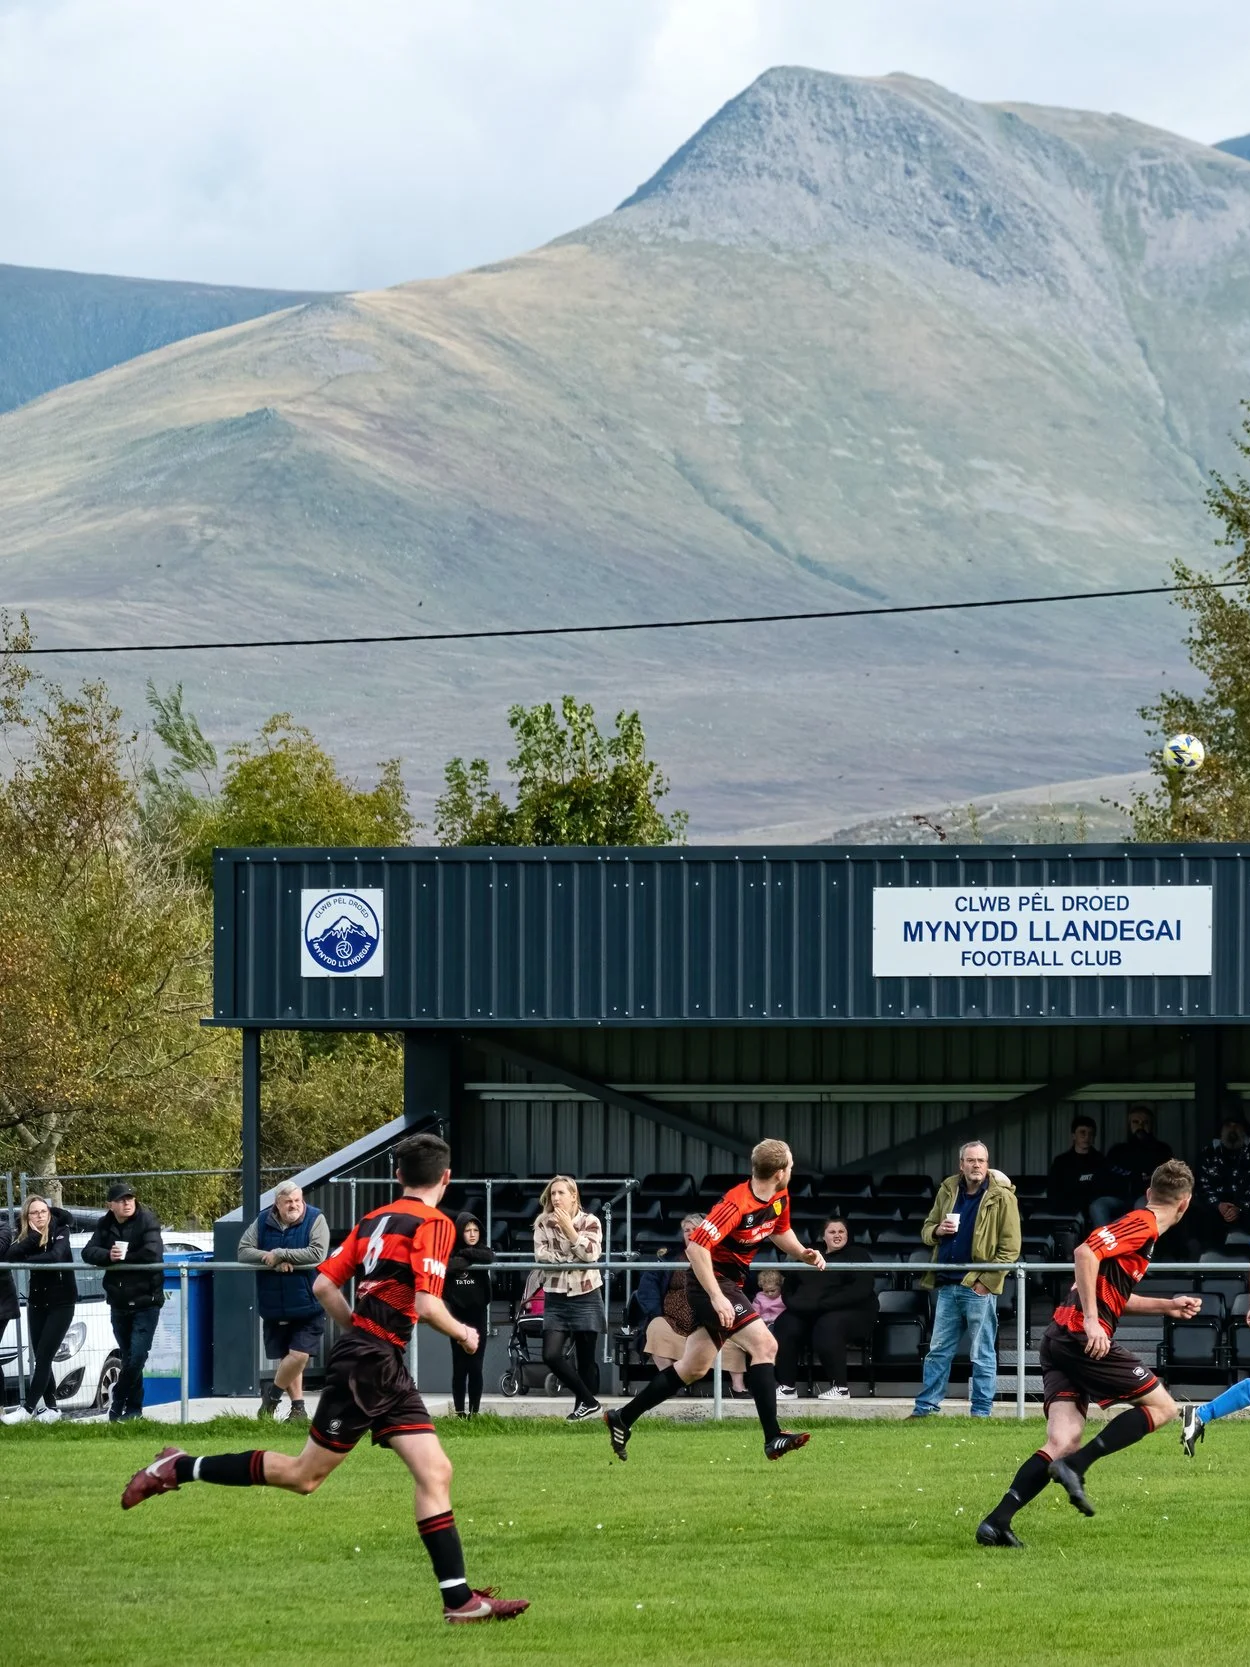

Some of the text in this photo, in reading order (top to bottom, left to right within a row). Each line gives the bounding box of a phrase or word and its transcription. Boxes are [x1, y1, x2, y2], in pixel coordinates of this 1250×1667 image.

[314, 901, 332, 919] CLWB
[348, 899, 369, 919] DROED
[954, 892, 1130, 912] CLWB PÊL DROED
[902, 919, 1182, 943] MYNYDD LLANDEGAI
[312, 942, 372, 968] MYNYDD LLANDEGAI
[961, 949, 1122, 967] FOOTBALL CLUB
[362, 1215, 392, 1276] 6
[1097, 1226, 1119, 1251] WR9
